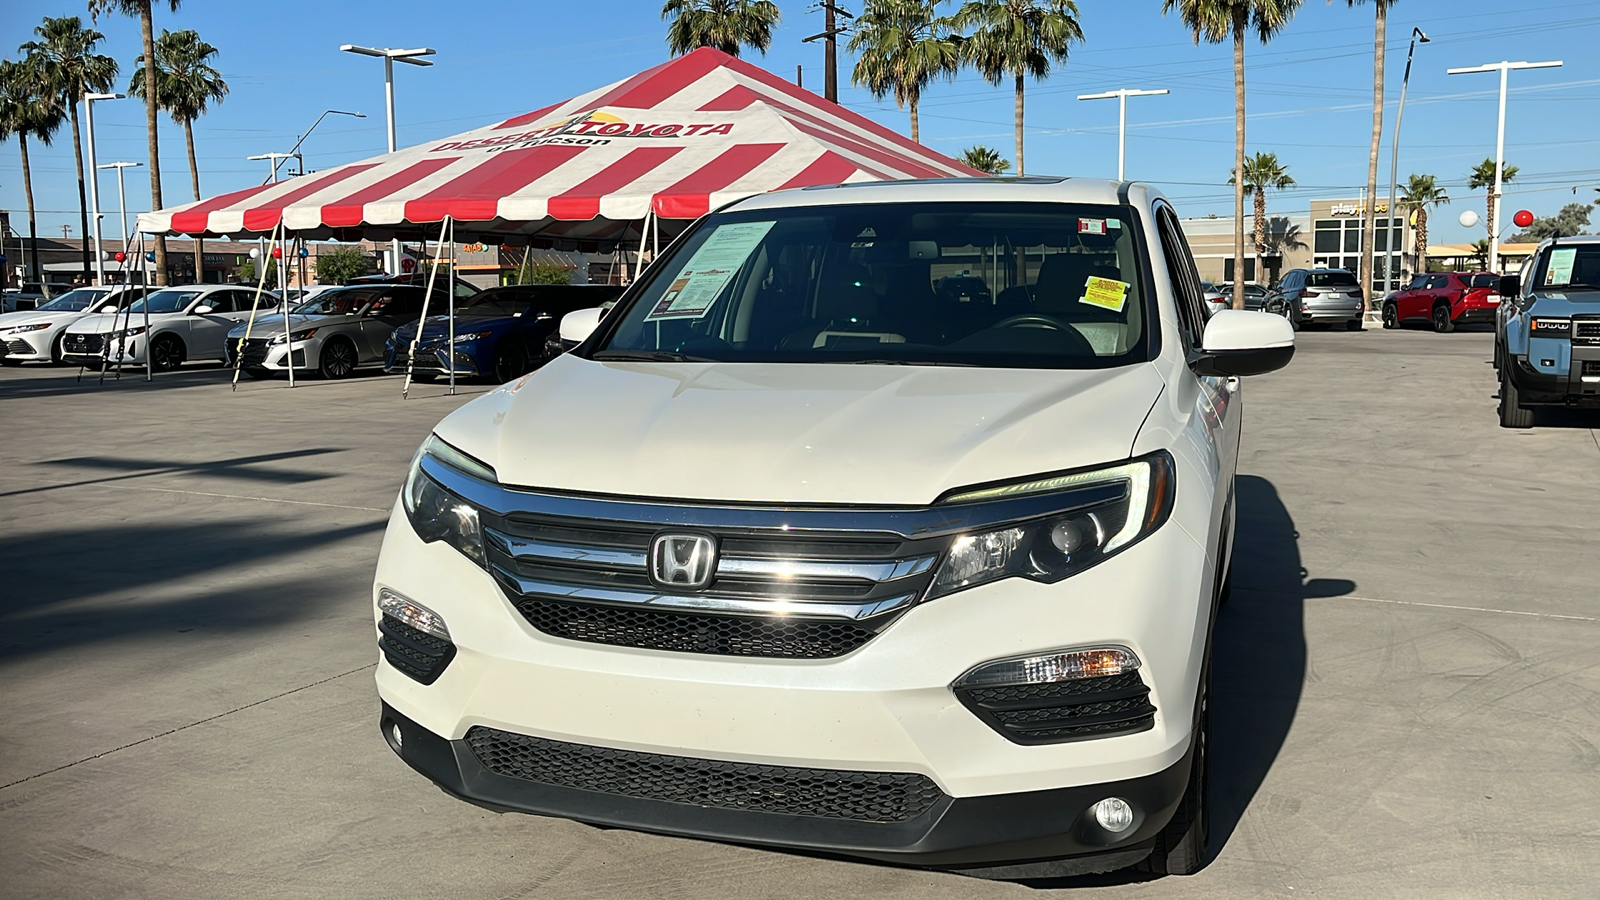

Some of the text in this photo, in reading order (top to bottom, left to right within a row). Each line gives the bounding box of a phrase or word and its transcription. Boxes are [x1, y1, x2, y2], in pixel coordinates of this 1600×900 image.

[428, 121, 735, 152] DESERT TOYOTA
[486, 137, 611, 153] of Tucson
